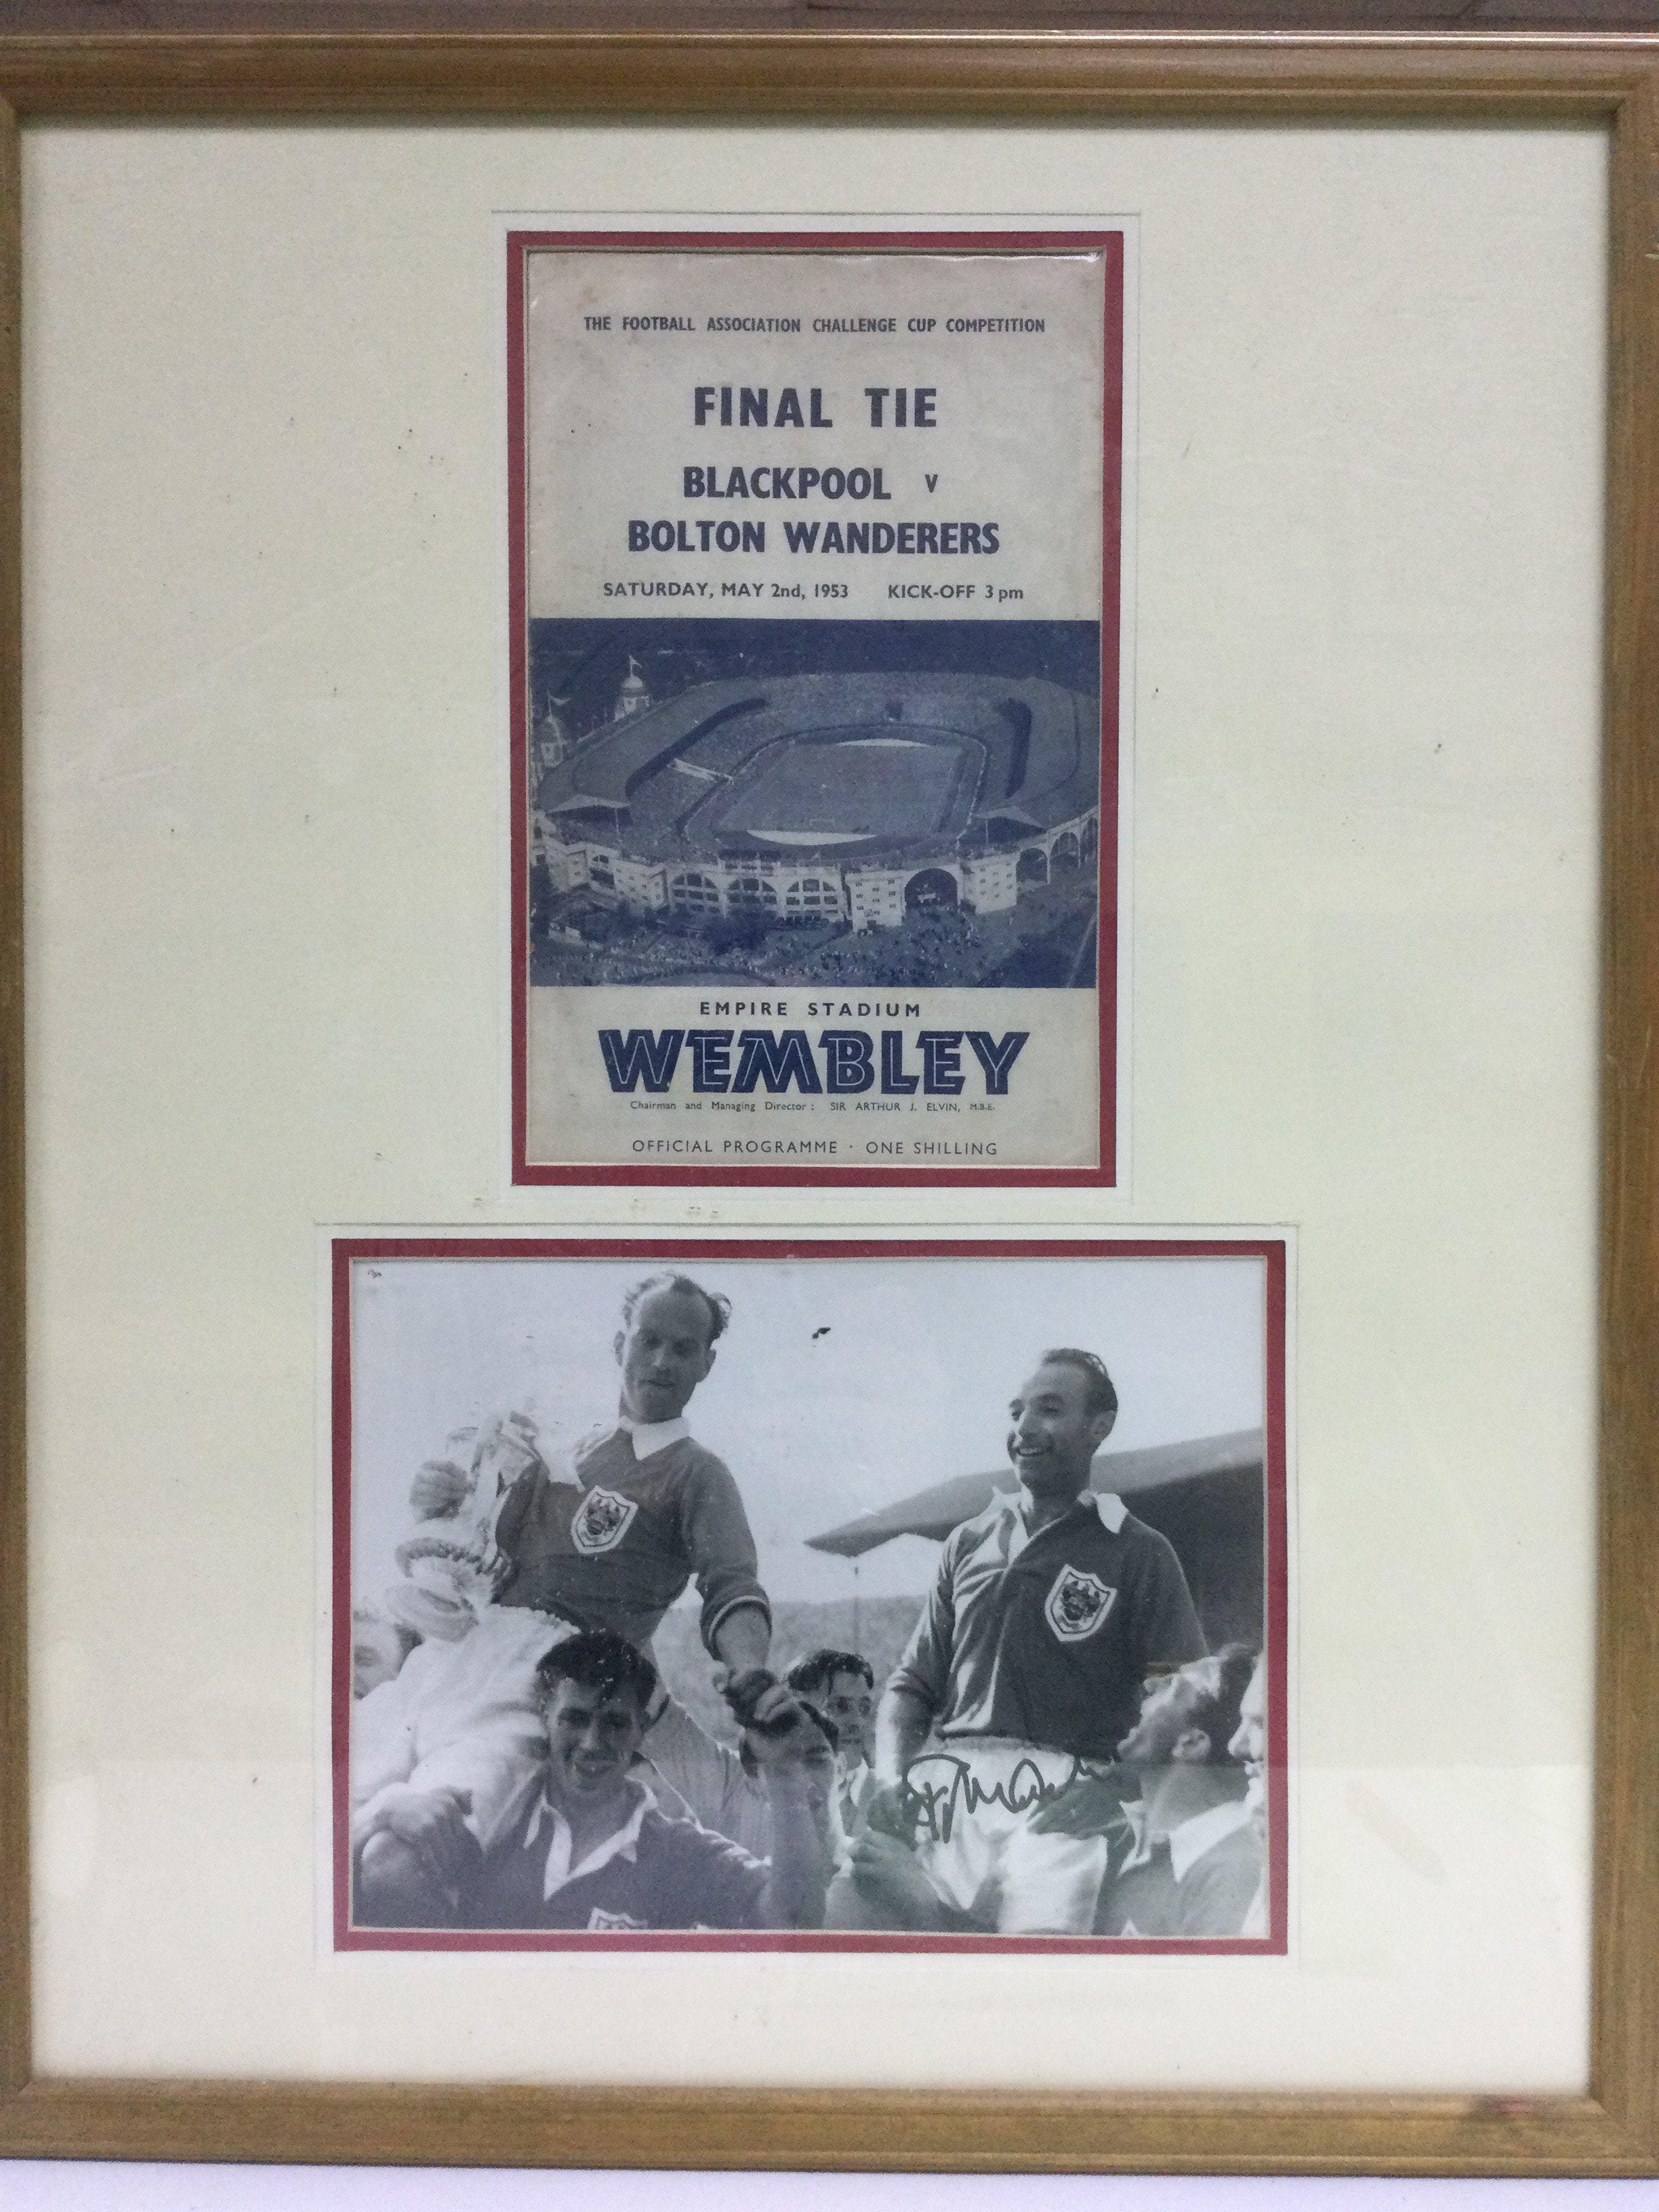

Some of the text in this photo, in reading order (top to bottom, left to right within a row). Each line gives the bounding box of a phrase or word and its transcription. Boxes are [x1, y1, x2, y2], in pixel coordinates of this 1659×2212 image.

[583, 315, 1045, 333] THE FOOTBALL ASSOCIATION CHALLENGE CUP COMPETITION
[694, 386, 937, 428] FINAL TIE
[683, 466, 939, 500] BLACKPOOL v
[628, 520, 1000, 554] BOLTON WANDERERS
[603, 581, 1024, 603] SATURDAY, MAY 2nd, 1953 KICK-OFF 3 pm
[700, 1001, 920, 1017] EMPIRE STADIUM
[598, 1029, 1030, 1095] WEMBLEY
[630, 1100, 677, 1110] Chairman
[684, 1101, 702, 1110] and
[711, 1101, 756, 1113] Managing
[830, 1101, 846, 1111] SIR
[855, 1101, 901, 1111] ARTHUR
[909, 1103, 918, 1111] J.
[926, 1102, 961, 1113] ELVIN,
[969, 1103, 995, 1111] M.B.E.
[632, 1139, 997, 1155] OFFICIAL PROGRAMME ONE SHILLING
